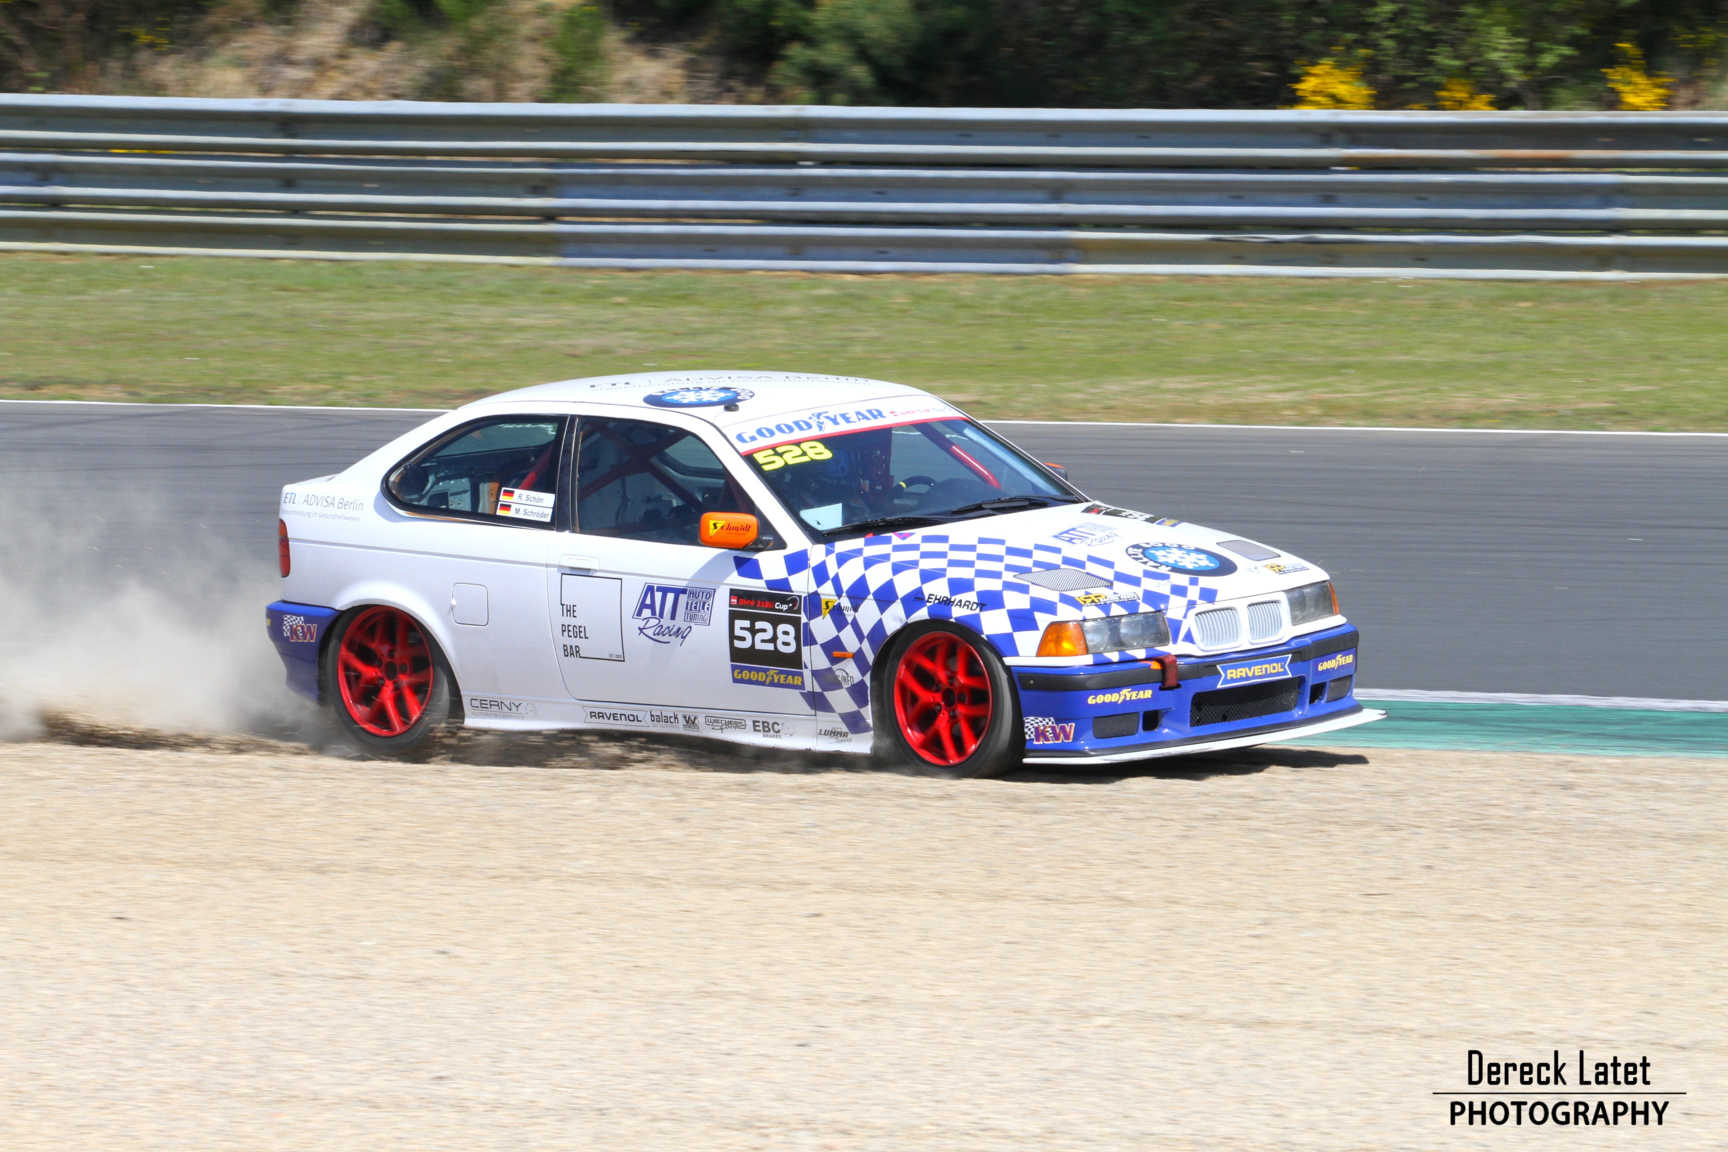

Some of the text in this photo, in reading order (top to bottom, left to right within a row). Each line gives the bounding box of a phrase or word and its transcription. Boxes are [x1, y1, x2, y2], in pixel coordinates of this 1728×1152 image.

[735, 408, 887, 443] GOODYEAR
[752, 440, 833, 472] 528
[561, 603, 577, 618] THE
[636, 585, 688, 620] ATT
[774, 602, 789, 612] Cup
[926, 593, 988, 613] EHRHARDT
[289, 624, 318, 642] KW
[561, 624, 589, 640] PEGEL
[638, 616, 692, 647] Racing
[733, 619, 797, 654] 528
[562, 643, 581, 658] BAR
[1317, 654, 1354, 671] GOODYEAR
[733, 668, 803, 686] GOODYEAR
[1226, 663, 1285, 681] RAVENOL
[470, 697, 523, 712] CERNY
[1087, 688, 1153, 704] GOODYEAR
[589, 711, 642, 723] RAVENOL
[752, 720, 781, 734] EBC
[1033, 722, 1075, 744] KW
